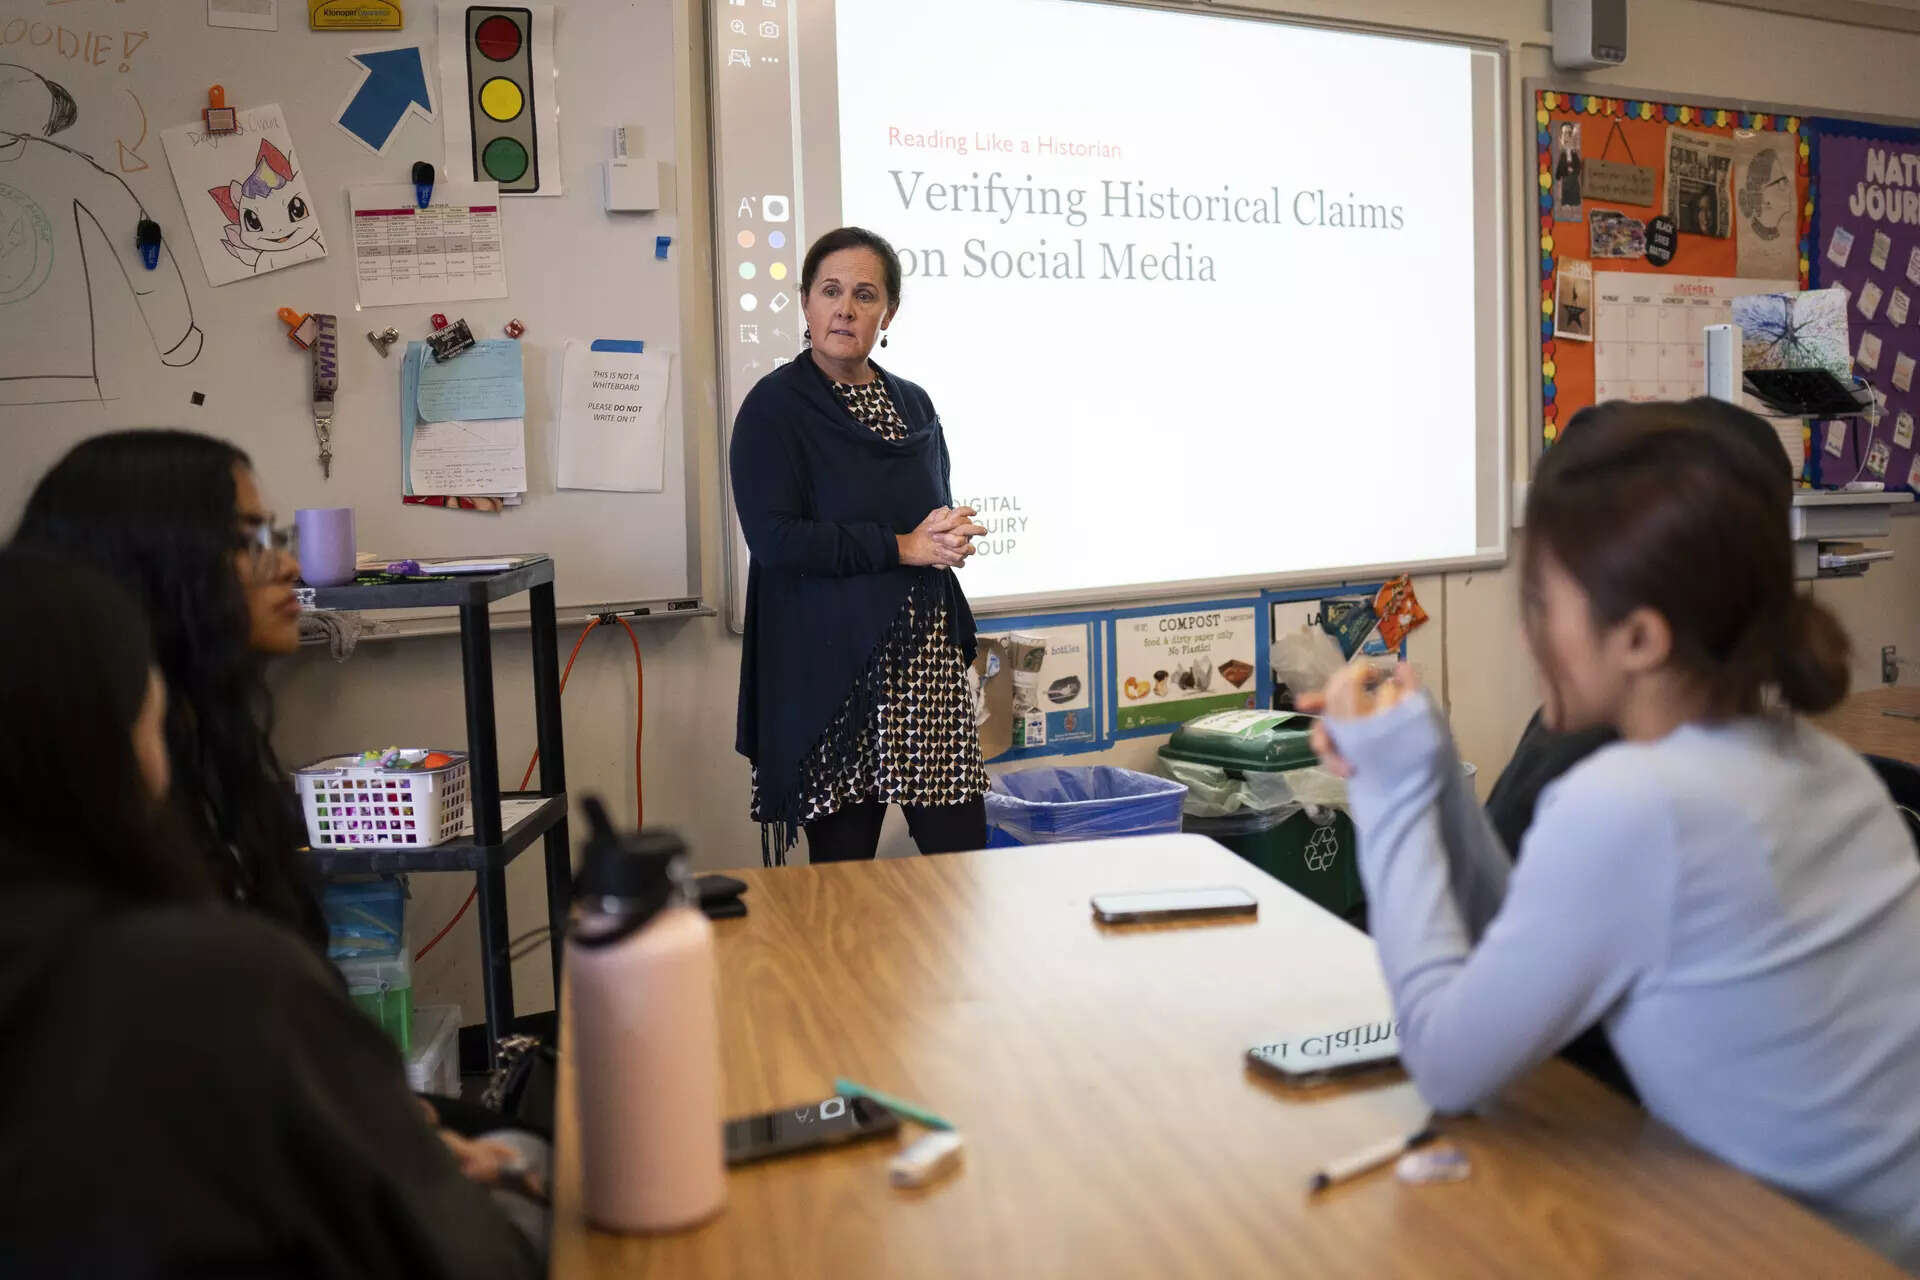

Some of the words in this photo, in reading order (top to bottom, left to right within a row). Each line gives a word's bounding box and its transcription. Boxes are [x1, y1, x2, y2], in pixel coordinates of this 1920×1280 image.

[0, 19, 149, 72] OODIE!
[888, 126, 968, 156] Reading
[976, 132, 1013, 153] Like
[1021, 140, 1030, 154] a
[1038, 136, 1121, 159] Historian
[887, 169, 1088, 227] Verifying
[1100, 180, 1282, 225] Historical
[1293, 189, 1405, 231] Claims
[1848, 181, 1920, 225] JOUR
[897, 247, 949, 278] on
[963, 238, 1086, 279] Social
[1098, 241, 1217, 283] Media
[593, 370, 608, 379] THIS
[592, 381, 640, 391] WHITEBOARD
[588, 402, 612, 411] PLEASE
[614, 404, 625, 412] DO
[593, 413, 615, 422] WRITE
[617, 415, 628, 423] ON
[977, 539, 1016, 556] OUP
[1159, 613, 1221, 632] COMPOST
[1307, 611, 1322, 626] LA
